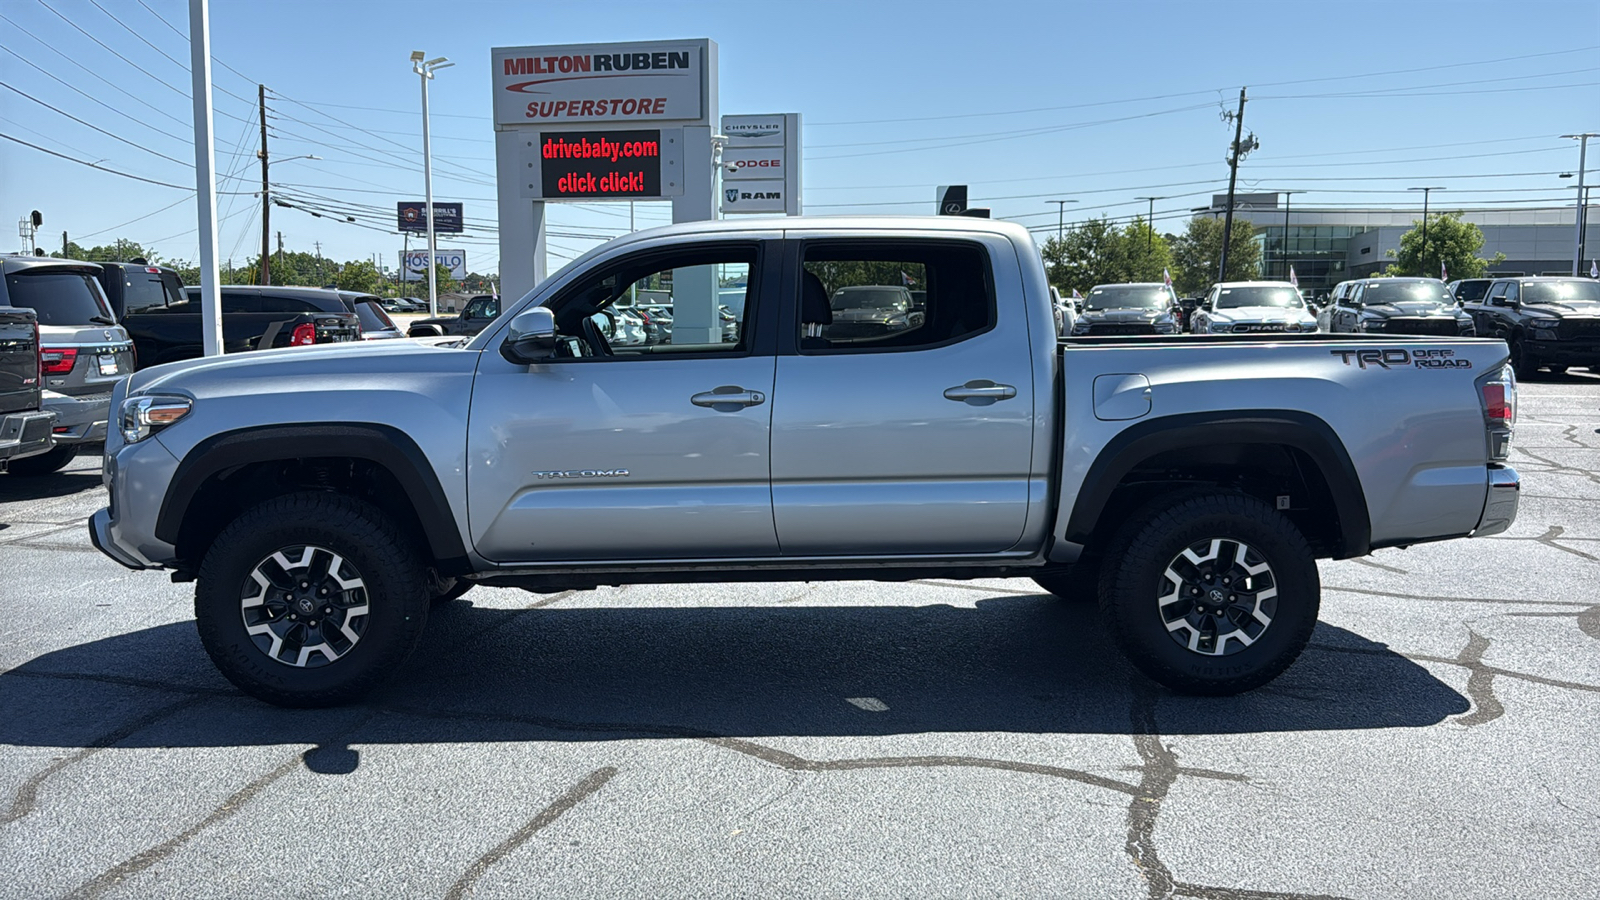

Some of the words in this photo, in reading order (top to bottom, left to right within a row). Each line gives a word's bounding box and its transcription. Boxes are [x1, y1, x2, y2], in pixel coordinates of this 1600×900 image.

[504, 55, 591, 75] MILTON
[593, 52, 689, 71] RUBEN
[525, 98, 667, 118] SUPERSTORE
[543, 137, 658, 162] drivebaby.com
[558, 172, 597, 192] click
[600, 171, 644, 192] click!
[1330, 349, 1411, 370] TRD
[1412, 349, 1455, 359] OFF
[1414, 359, 1472, 370] ROAD
[532, 468, 630, 479] TACOMA
